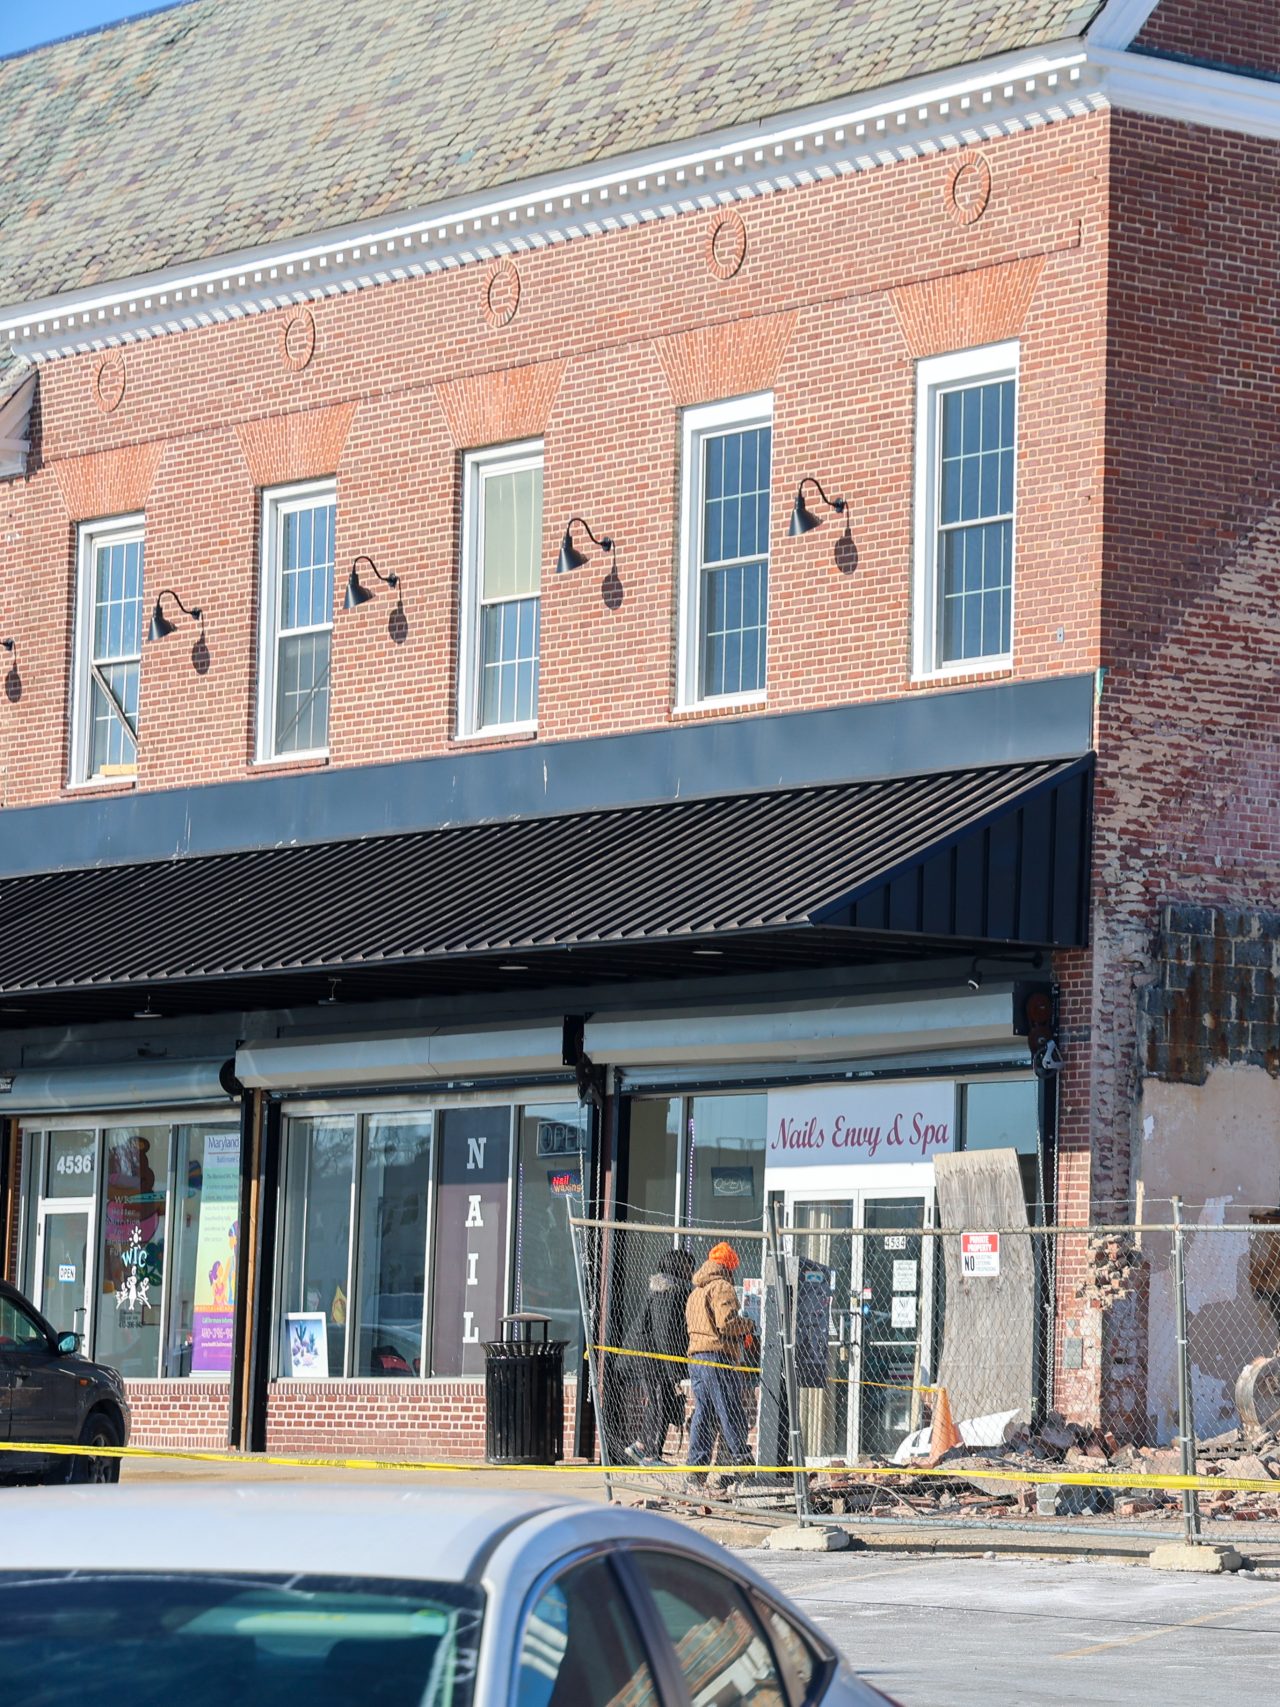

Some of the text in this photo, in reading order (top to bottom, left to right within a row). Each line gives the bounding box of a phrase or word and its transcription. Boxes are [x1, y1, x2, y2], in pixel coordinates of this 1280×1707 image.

[771, 1112, 949, 1157] Nails Envy & Spa
[57, 1155, 91, 1174] 4536
[463, 1137, 487, 1343] NAIL
[885, 1237, 905, 1248] 4534
[122, 1247, 147, 1268] WIC
[964, 1255, 975, 1271] NO
[59, 1267, 75, 1279] OPEN
